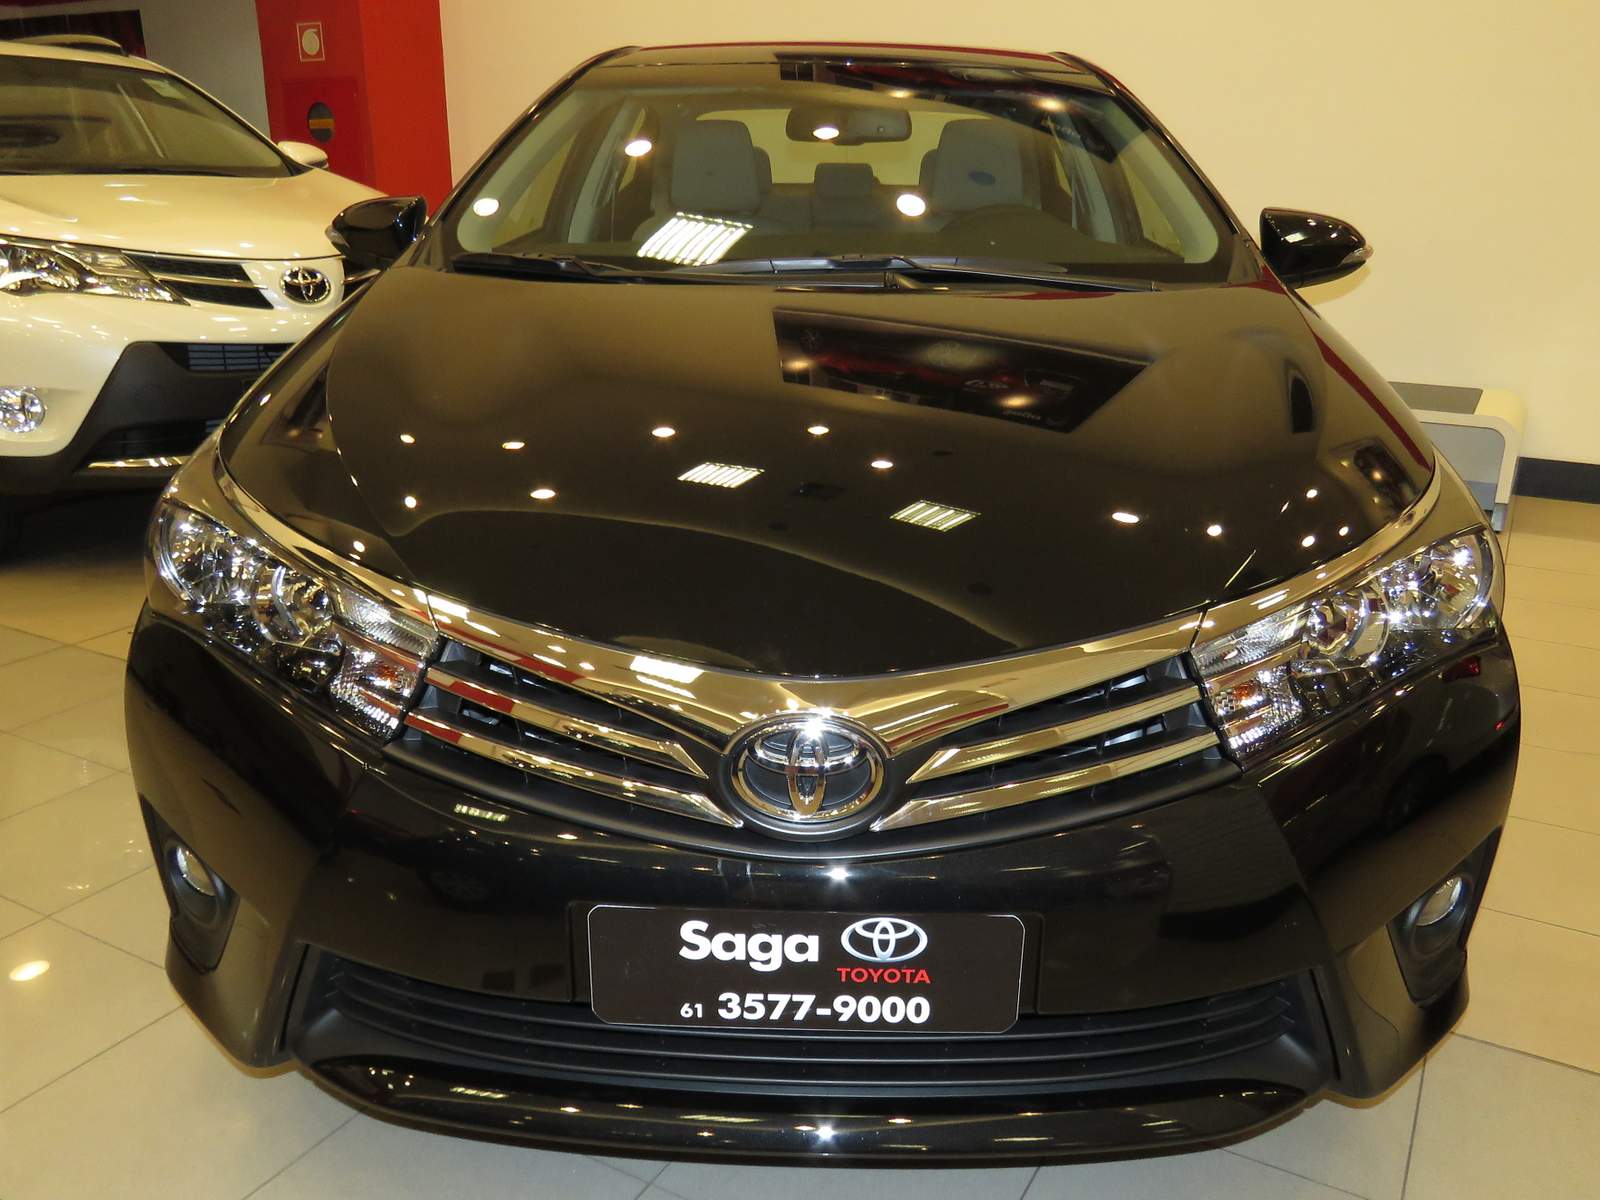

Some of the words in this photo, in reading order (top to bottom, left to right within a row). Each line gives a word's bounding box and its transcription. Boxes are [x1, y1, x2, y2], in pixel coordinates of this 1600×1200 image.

[678, 920, 820, 972] Saga
[836, 966, 931, 985] TOYOTA
[680, 1002, 703, 1019] 61
[717, 992, 931, 1024] 3577-9000
